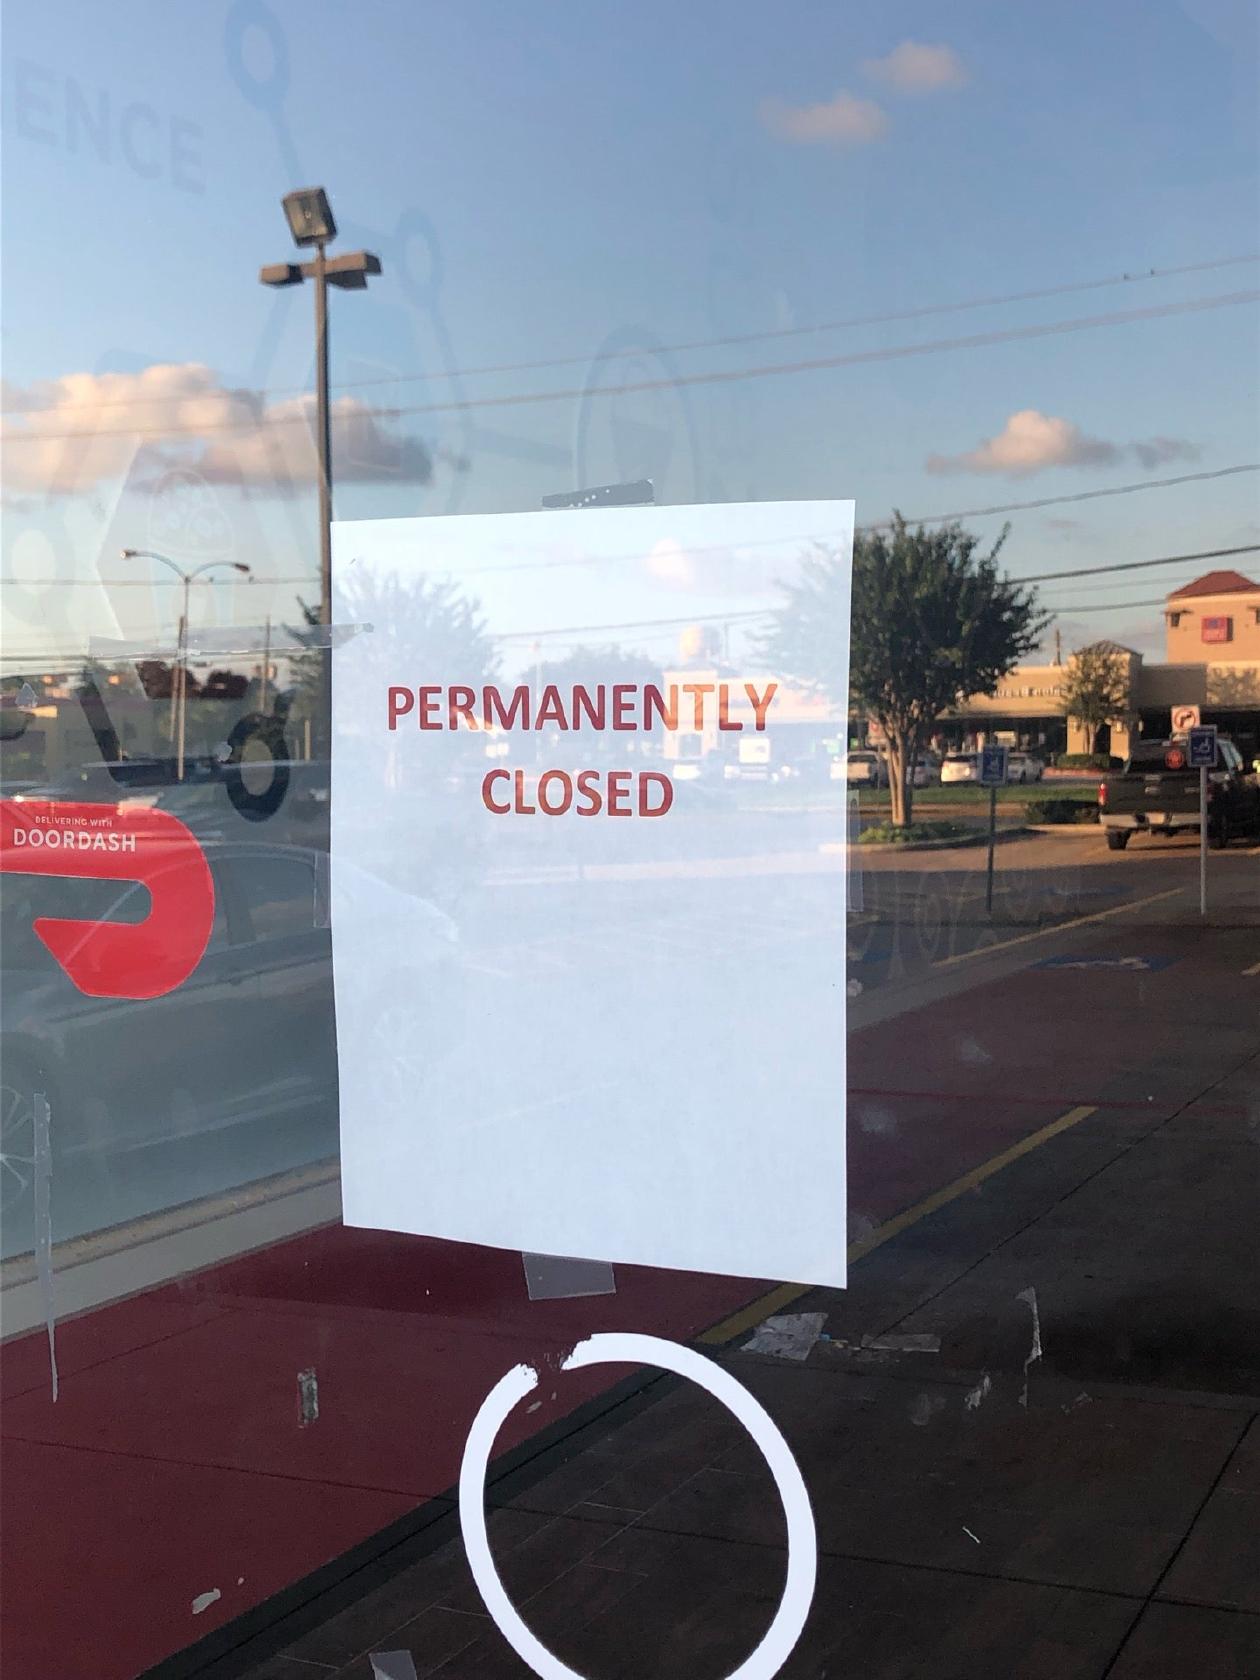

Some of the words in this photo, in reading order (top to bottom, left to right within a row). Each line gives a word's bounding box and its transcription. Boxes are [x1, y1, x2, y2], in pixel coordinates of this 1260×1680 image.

[387, 683, 778, 732] PERMANENTLY
[482, 769, 674, 818] CLOSED
[35, 815, 88, 827] DELIVERING
[89, 818, 113, 828] WITH
[13, 828, 136, 852] DOORDASH
